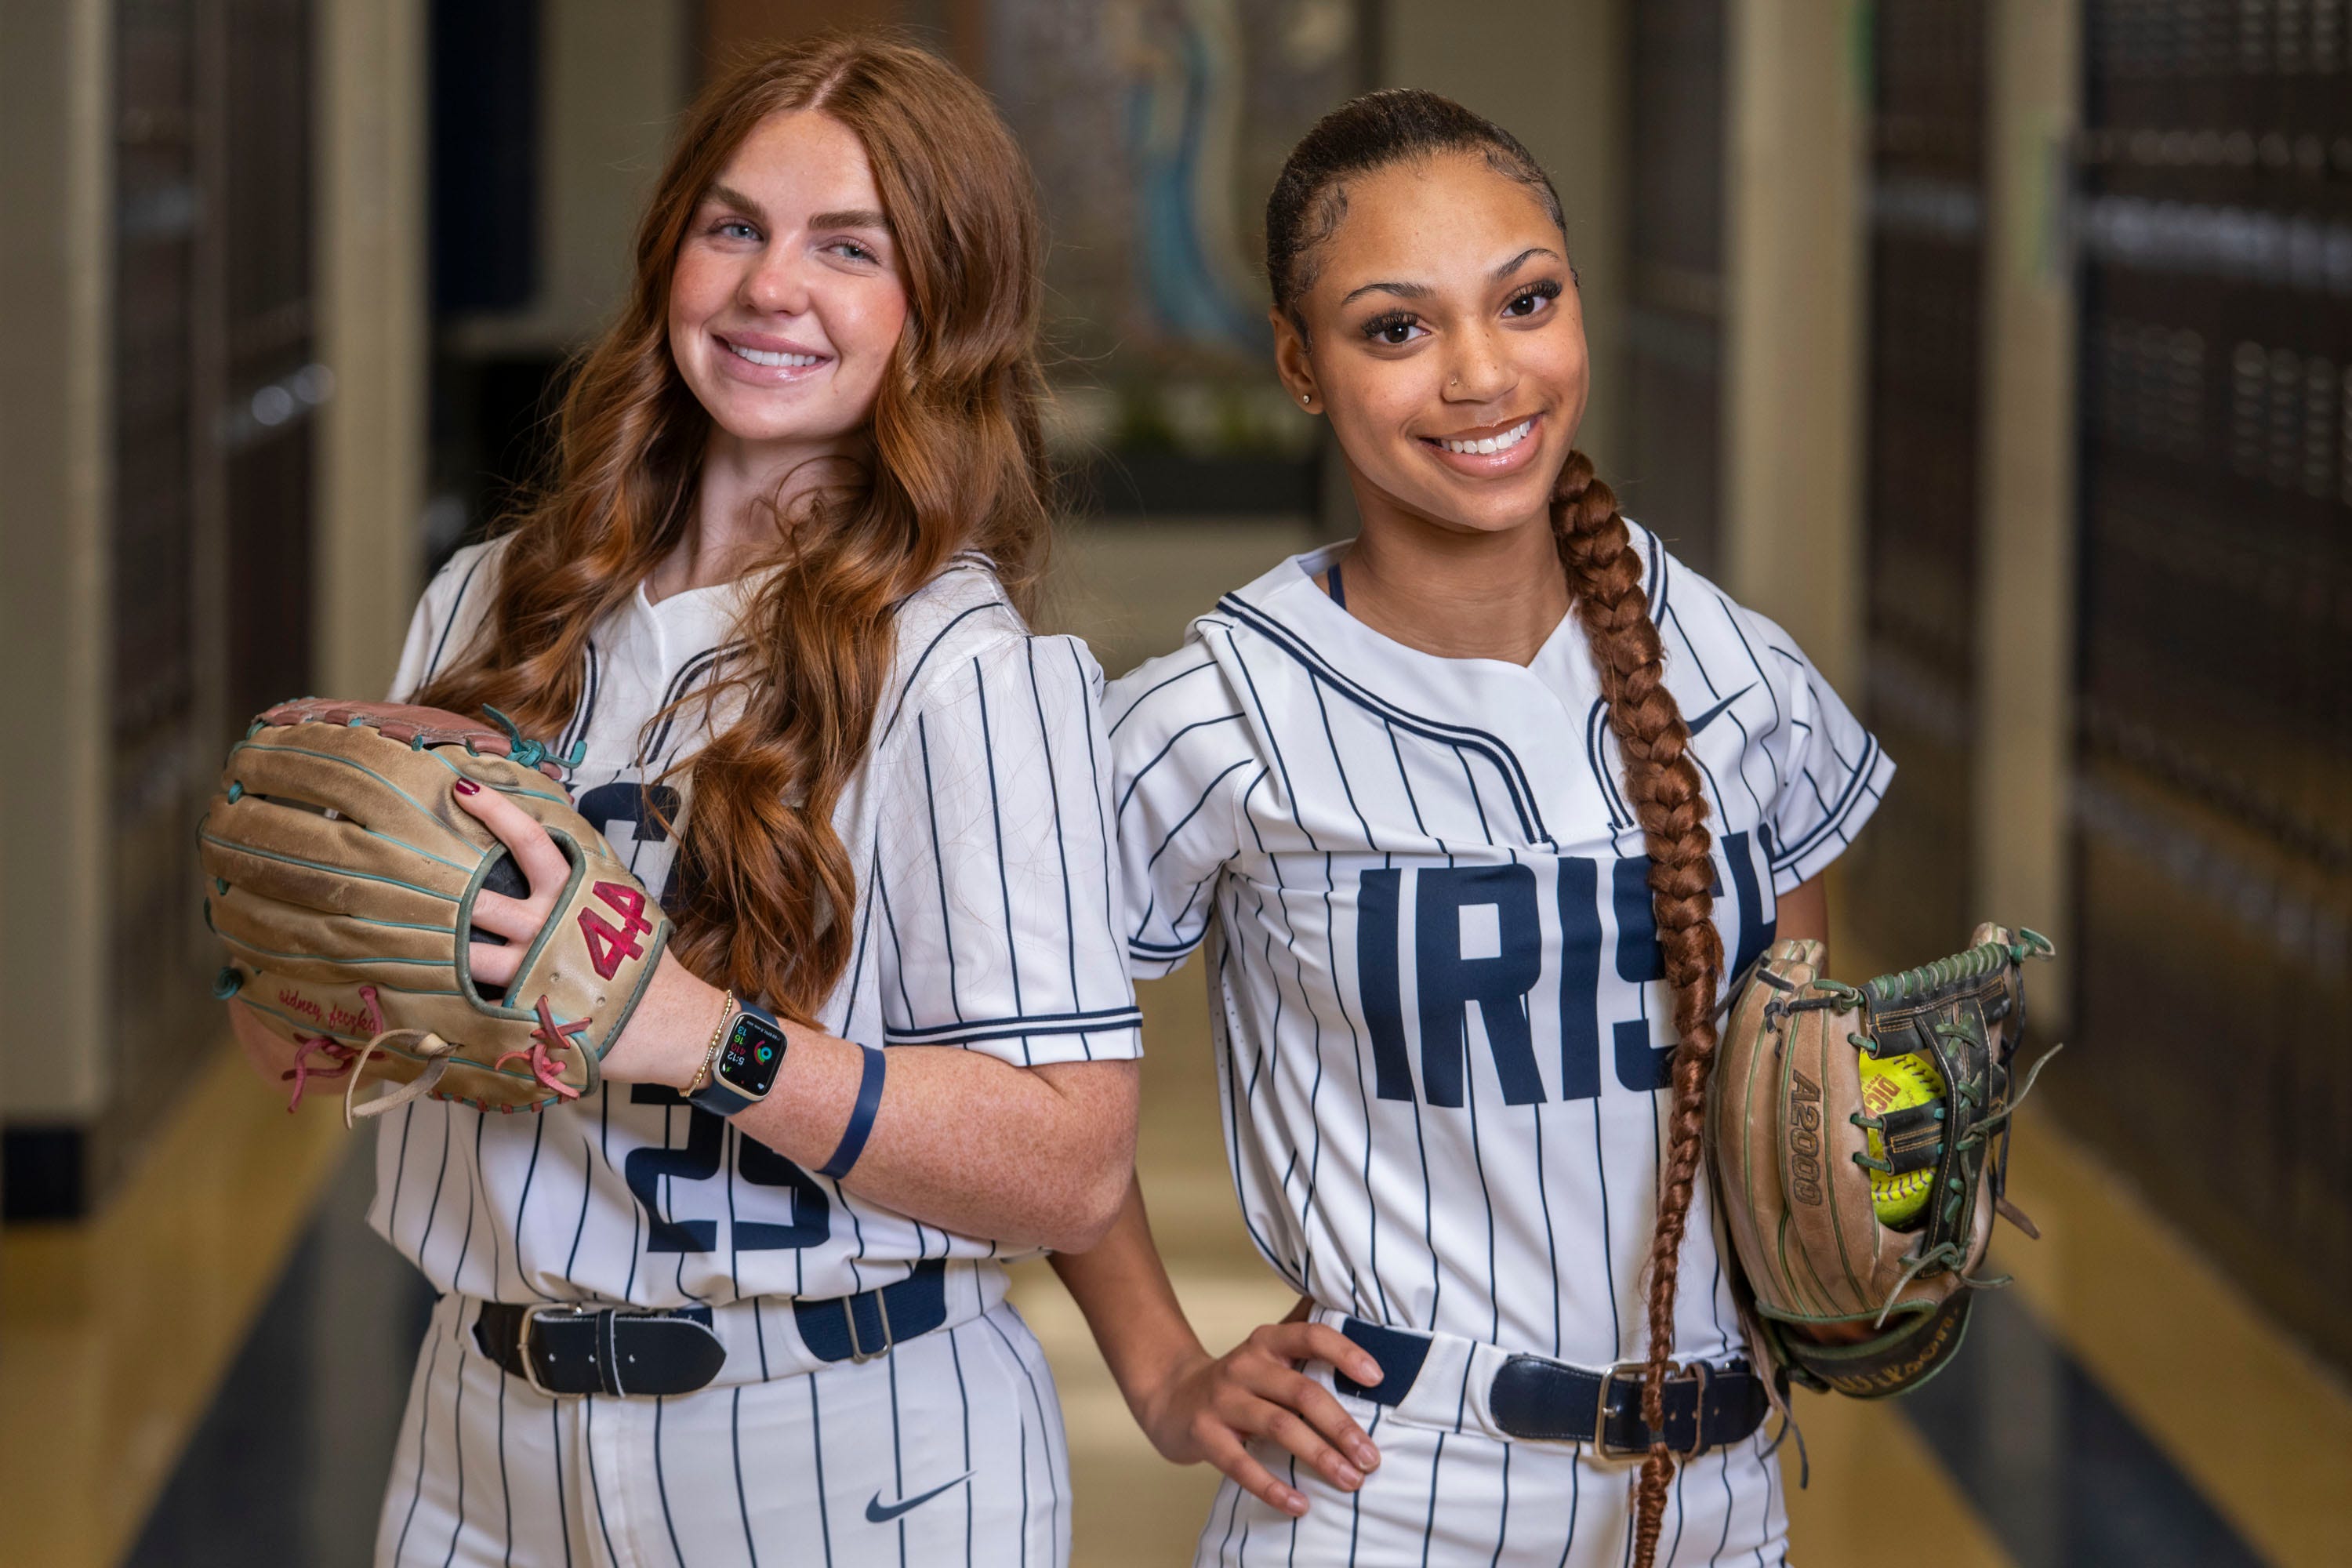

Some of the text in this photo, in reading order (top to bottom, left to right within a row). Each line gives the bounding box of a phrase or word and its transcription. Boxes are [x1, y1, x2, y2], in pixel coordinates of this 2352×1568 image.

[577, 880, 653, 981] 44
[734, 1034, 744, 1045] 16
[737, 1025, 747, 1036] 13
[727, 1051, 745, 1066] 5:12
[1865, 1076, 1901, 1118] DIC
[1790, 1069, 1823, 1206] A2000
[625, 1083, 831, 1253] 25
